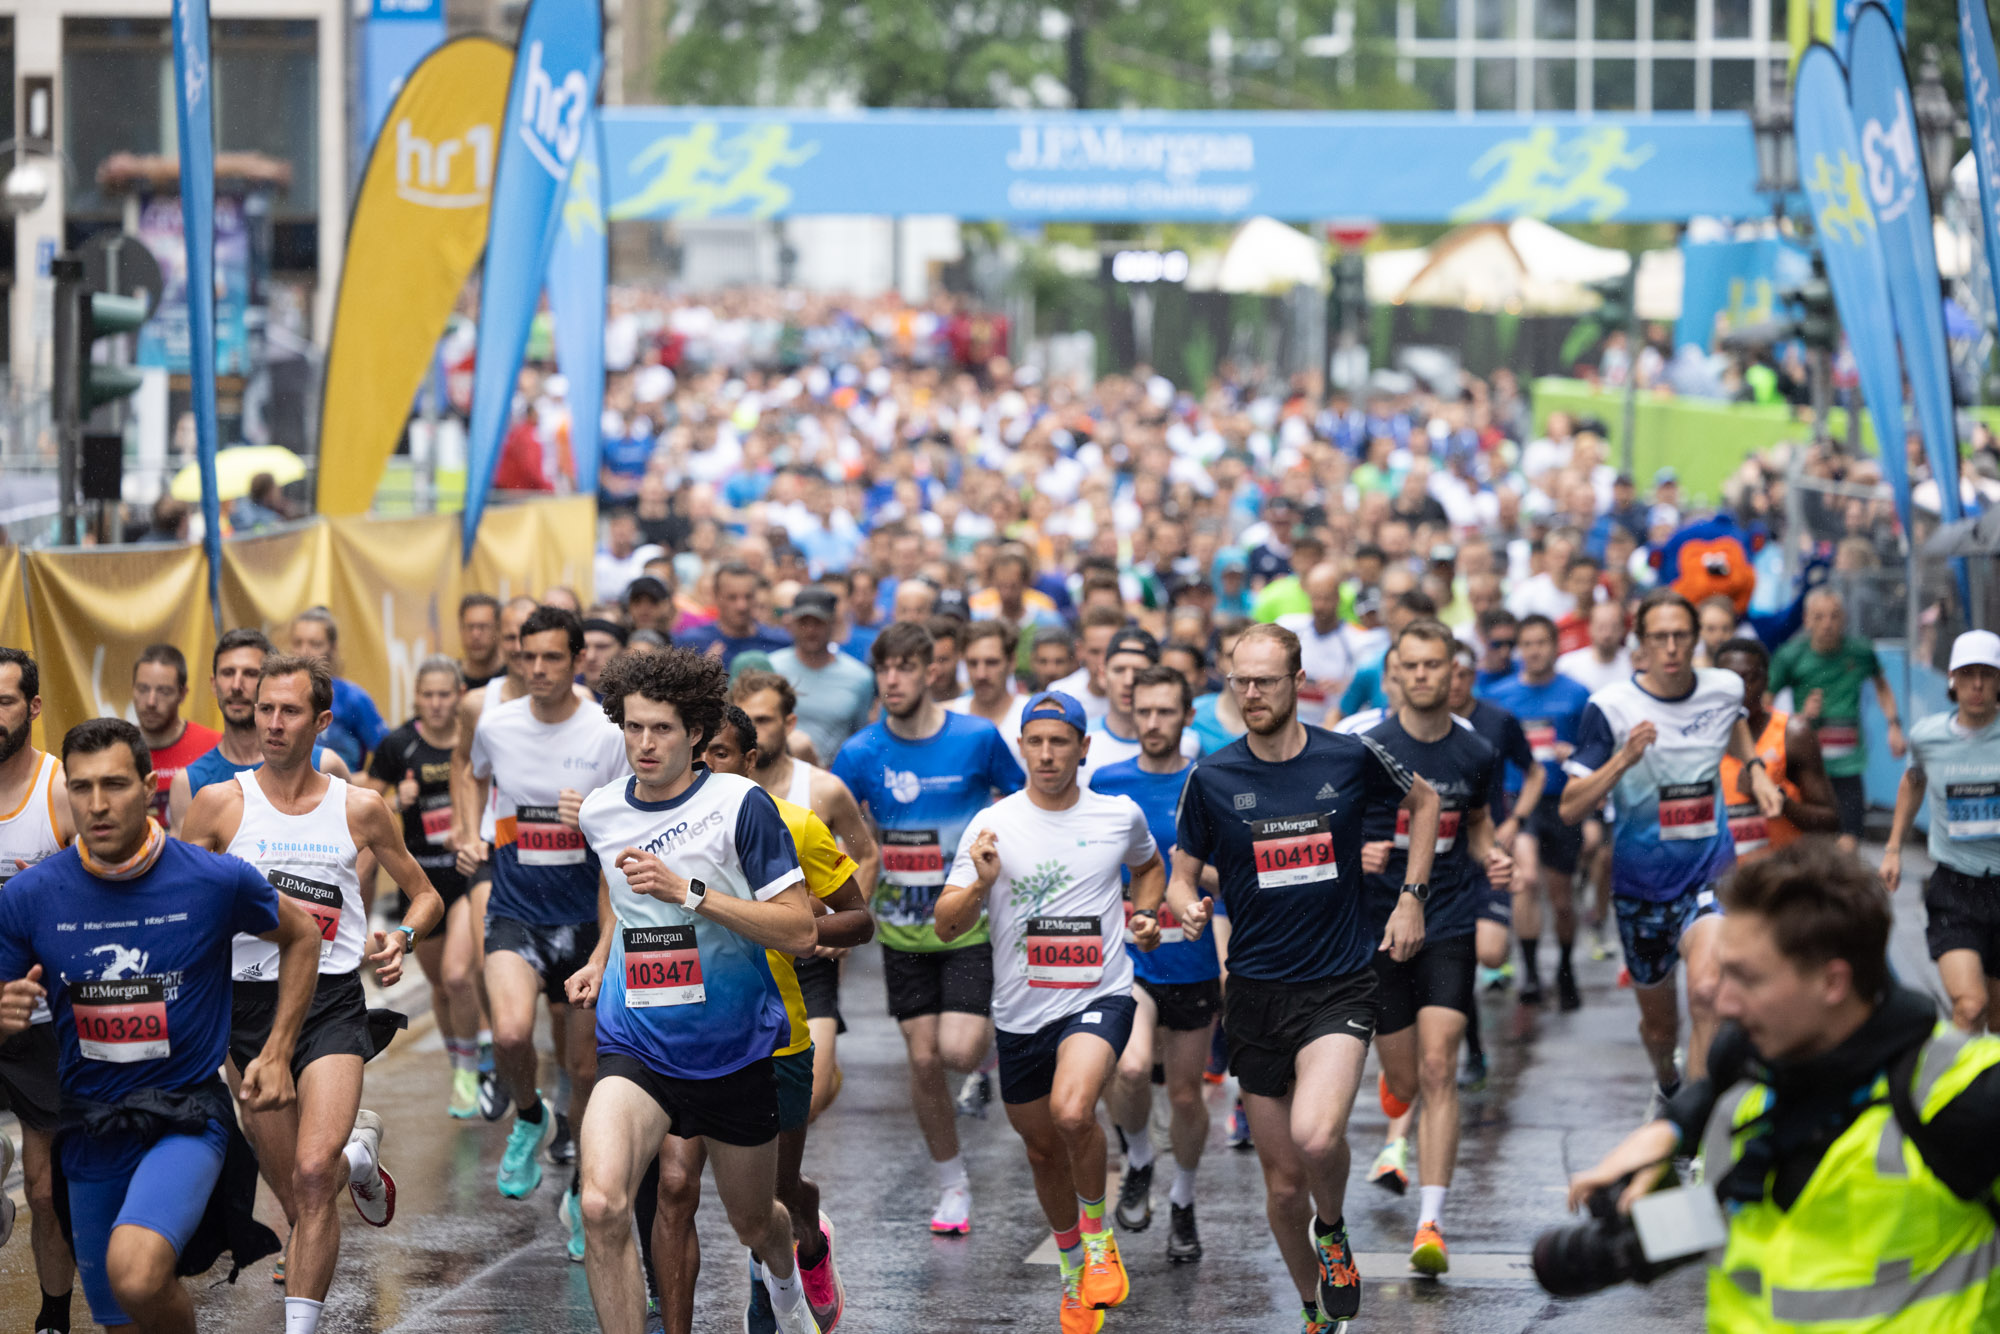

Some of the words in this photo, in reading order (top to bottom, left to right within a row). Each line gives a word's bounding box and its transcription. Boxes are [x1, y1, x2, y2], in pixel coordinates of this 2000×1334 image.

[521, 40, 588, 162] hr3
[396, 118, 493, 190] hr1
[1237, 795, 1254, 808] DB
[1262, 819, 1319, 834] J.P.Morgan
[271, 842, 340, 854] SCHOLARBOOK
[521, 832, 580, 849] 10189
[884, 853, 938, 870] 10270
[1261, 843, 1330, 869] 10419
[276, 877, 335, 900] J.P.Morgan
[105, 920, 138, 929] CONSULTING
[1037, 919, 1092, 932] J.P.Morgan
[630, 932, 684, 947] J.P.Morgan
[1031, 944, 1099, 965] 10430
[629, 960, 695, 986] 10347
[80, 984, 150, 1001] J.P.Morgan
[80, 1015, 162, 1041] 10329
